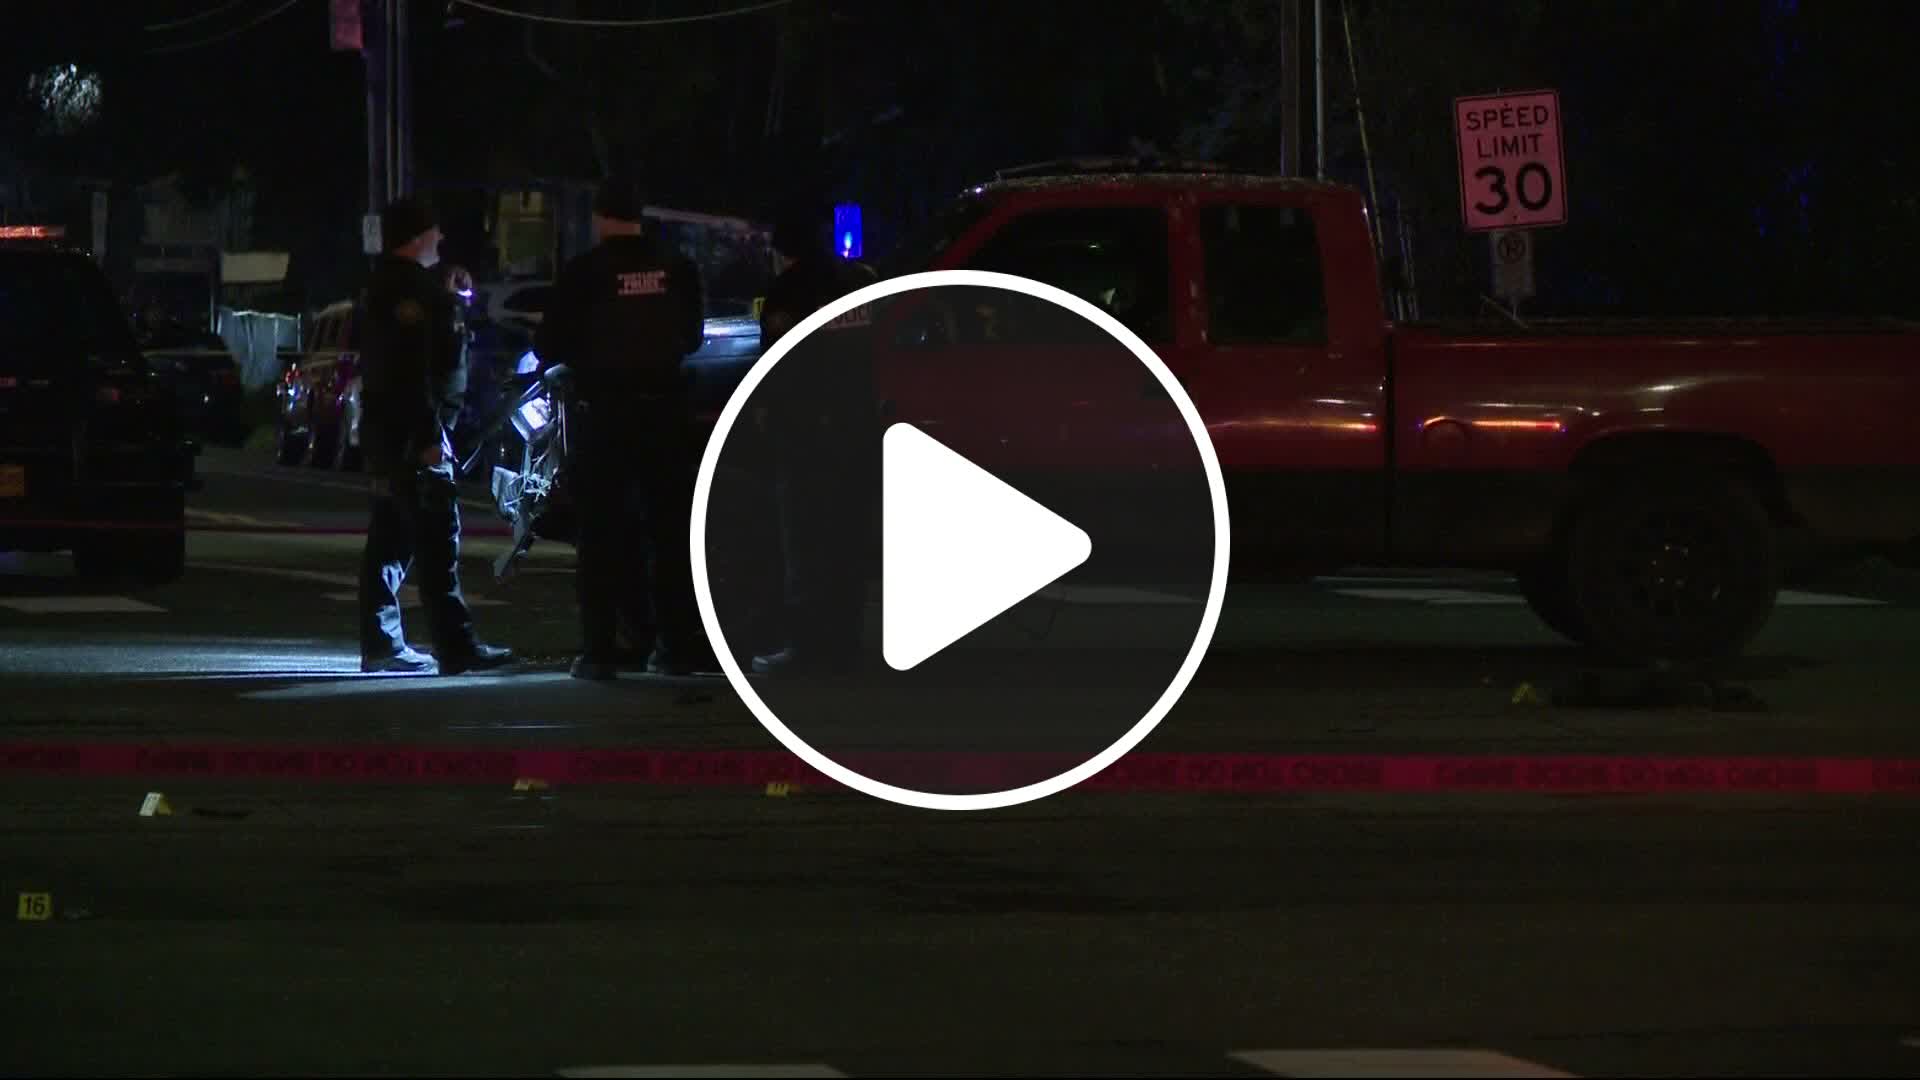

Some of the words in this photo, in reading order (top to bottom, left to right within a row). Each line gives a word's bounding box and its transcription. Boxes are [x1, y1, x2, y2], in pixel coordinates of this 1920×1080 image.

[1465, 105, 1549, 131] SPEED
[1476, 134, 1544, 158] LIMIT
[1475, 163, 1552, 215] 30
[23, 896, 46, 915] 16
